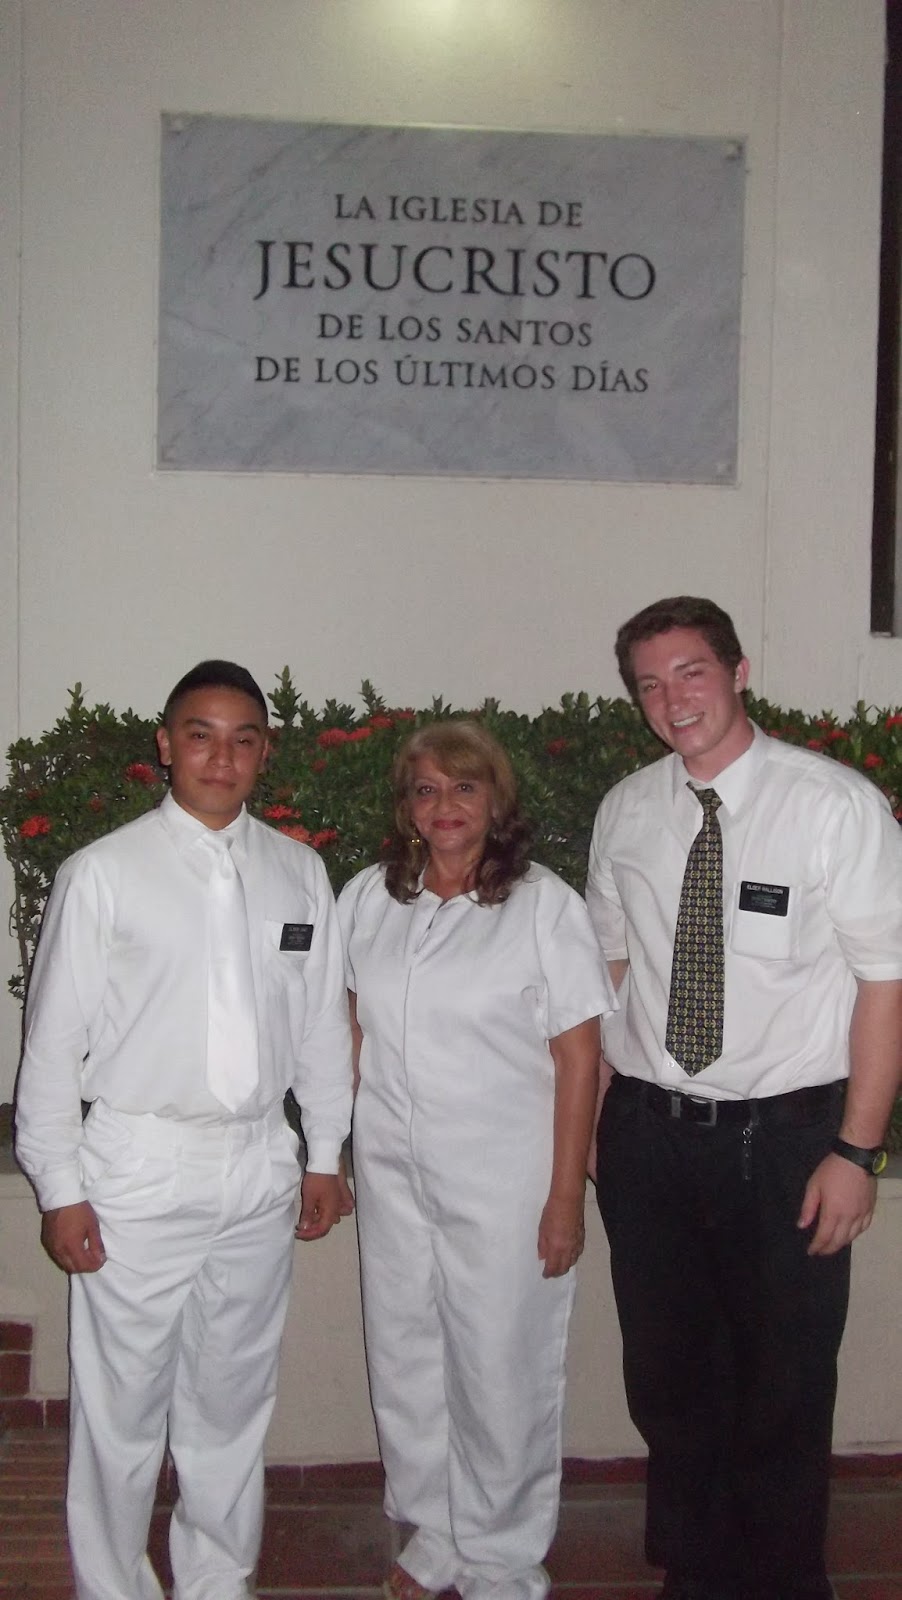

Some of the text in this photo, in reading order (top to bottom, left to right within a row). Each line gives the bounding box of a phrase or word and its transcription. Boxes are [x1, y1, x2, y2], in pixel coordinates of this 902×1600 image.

[335, 194, 583, 228] LA IGLESIA DE
[253, 240, 657, 301] JESUCRISTO
[318, 314, 592, 348] DE LOS SANTOS
[255, 355, 649, 393] DE LOS ÚLTIMOS DÍAS
